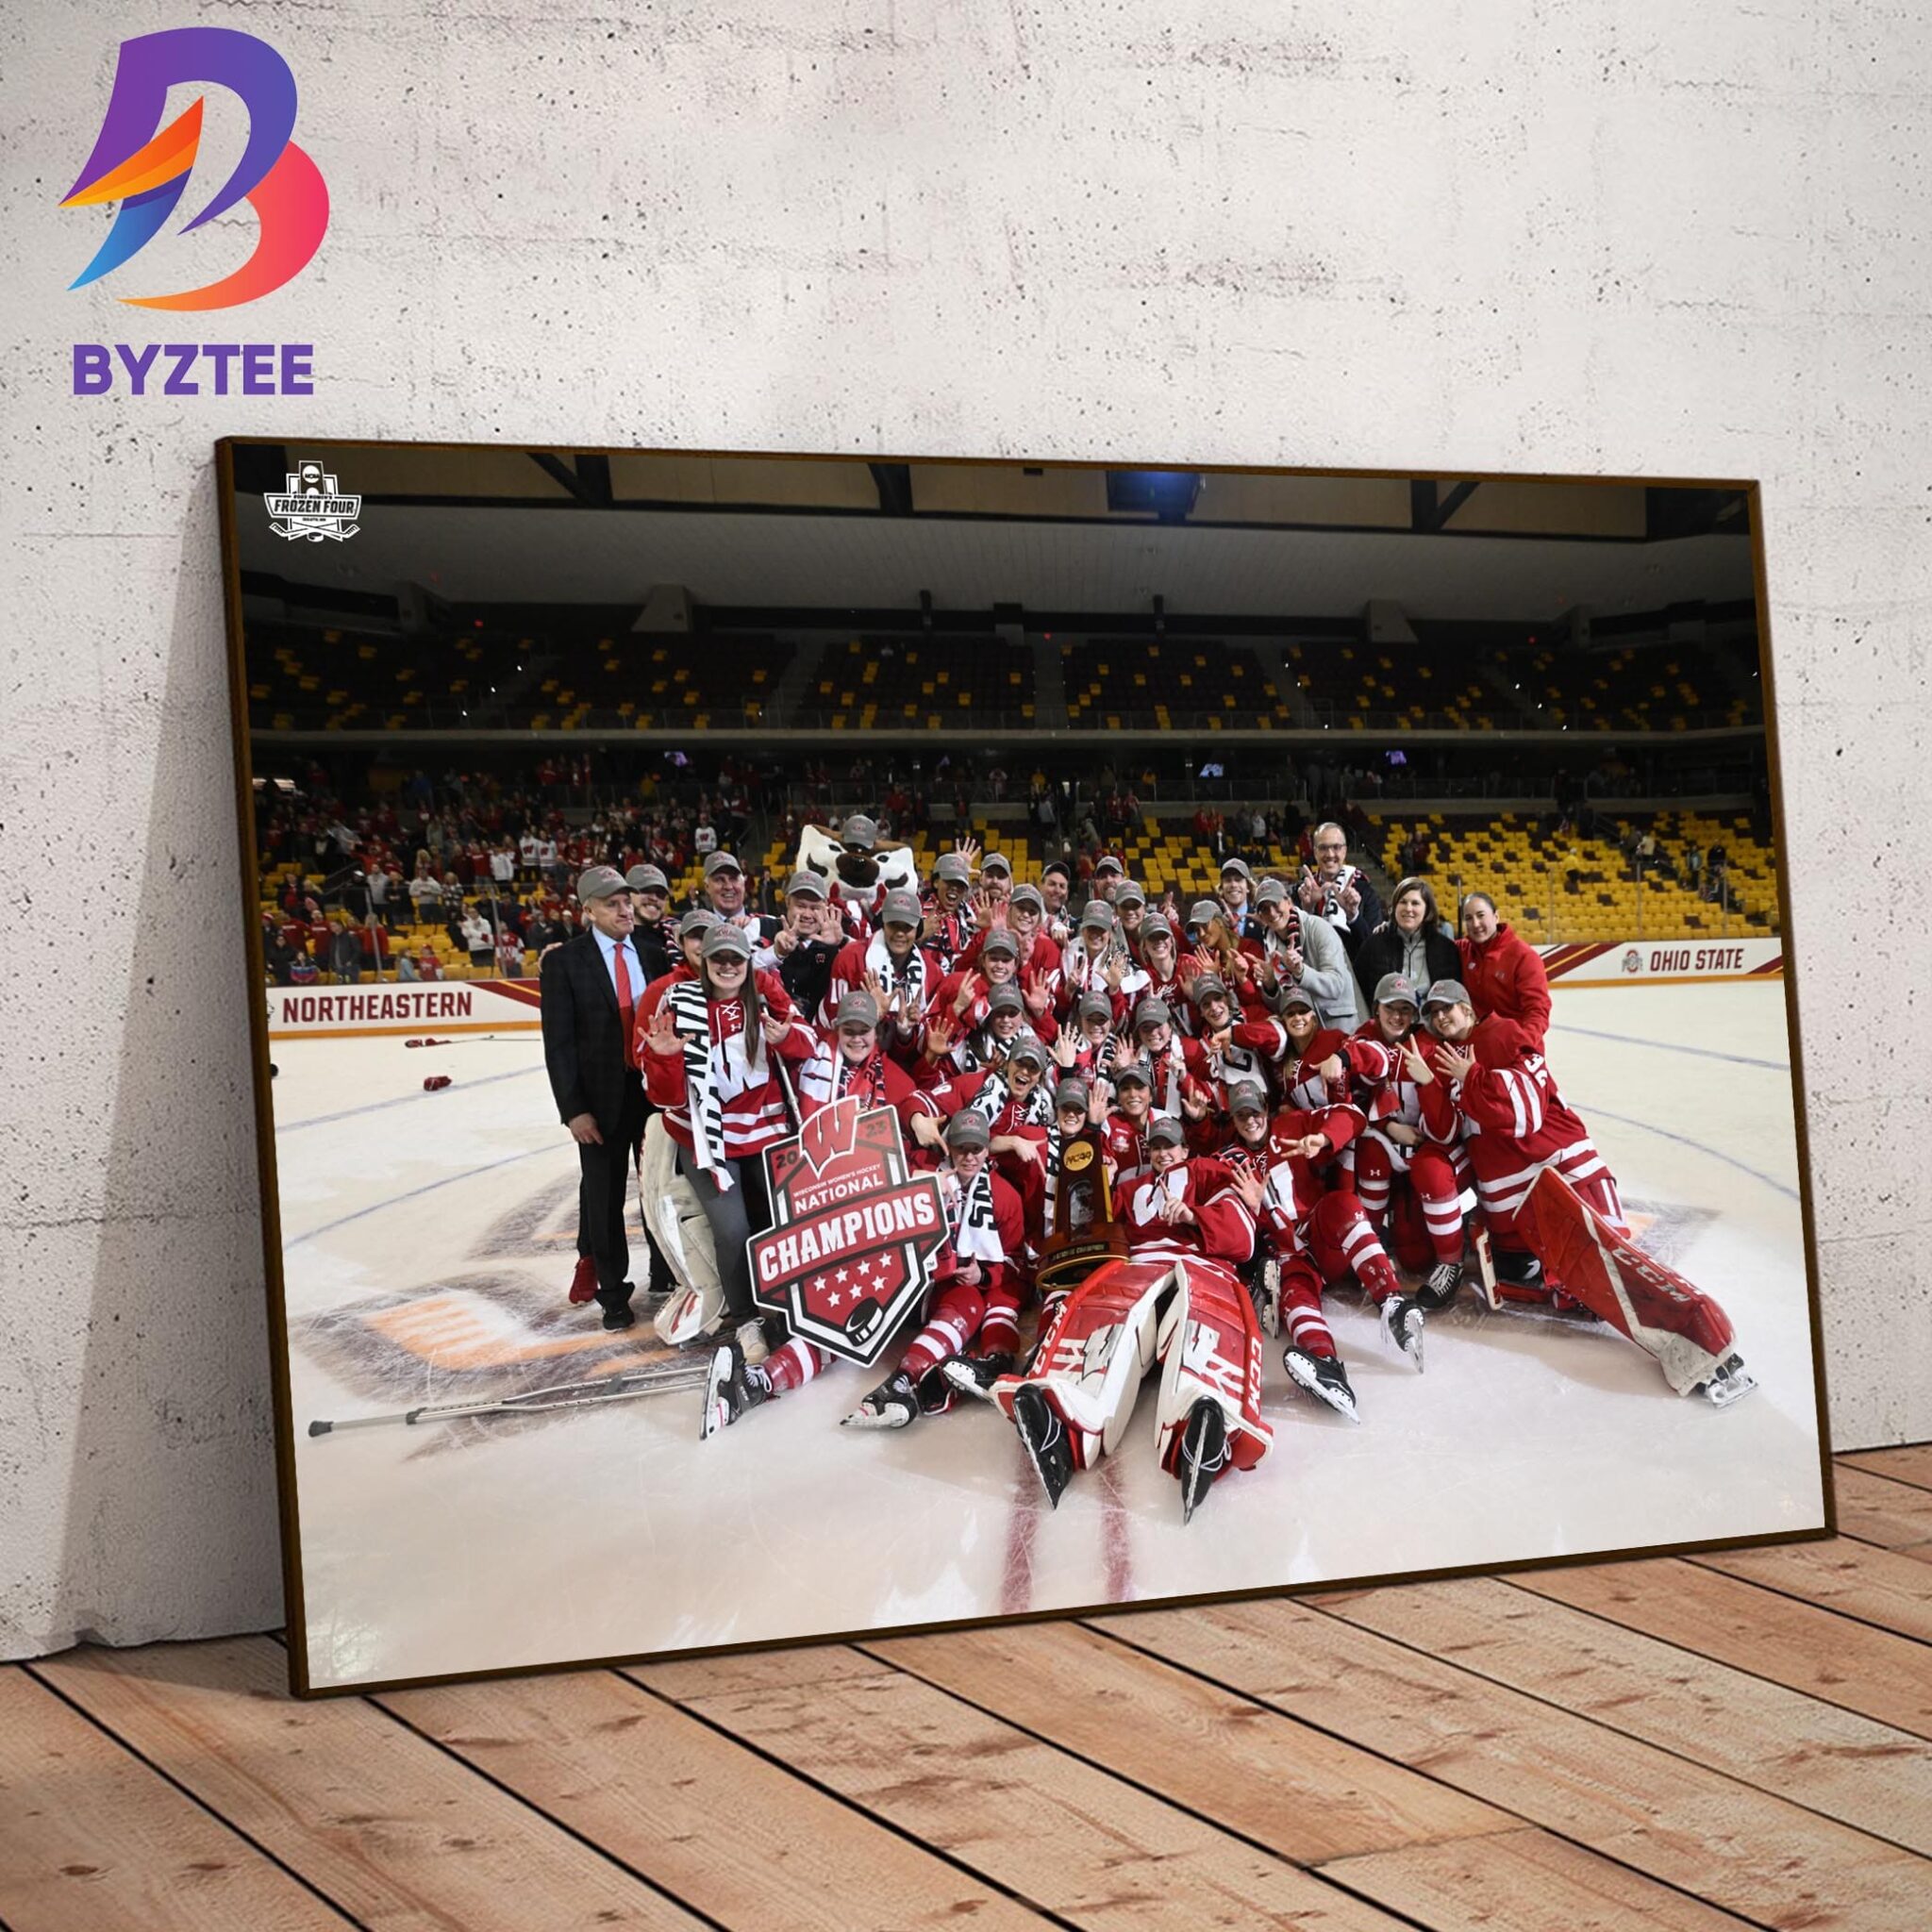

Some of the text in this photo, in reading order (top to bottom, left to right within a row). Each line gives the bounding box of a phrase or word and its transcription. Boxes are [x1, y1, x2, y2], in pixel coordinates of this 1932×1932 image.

[274, 499, 355, 514] FROZEN FOUR
[1650, 948, 1744, 971] OHIO STATE
[283, 991, 472, 1023] NORTHEASTERN
[865, 1121, 887, 1138] 23
[775, 1151, 799, 1169] 20
[793, 1163, 881, 1198] WISCONSIN WOMEN'S HOCKEY
[794, 1174, 883, 1214] NATIONAL
[759, 1192, 935, 1281] CHAMPIONS
[1612, 1246, 1691, 1302] CCM
[1034, 1302, 1067, 1374] CCM
[1248, 1337, 1262, 1416] CCM
